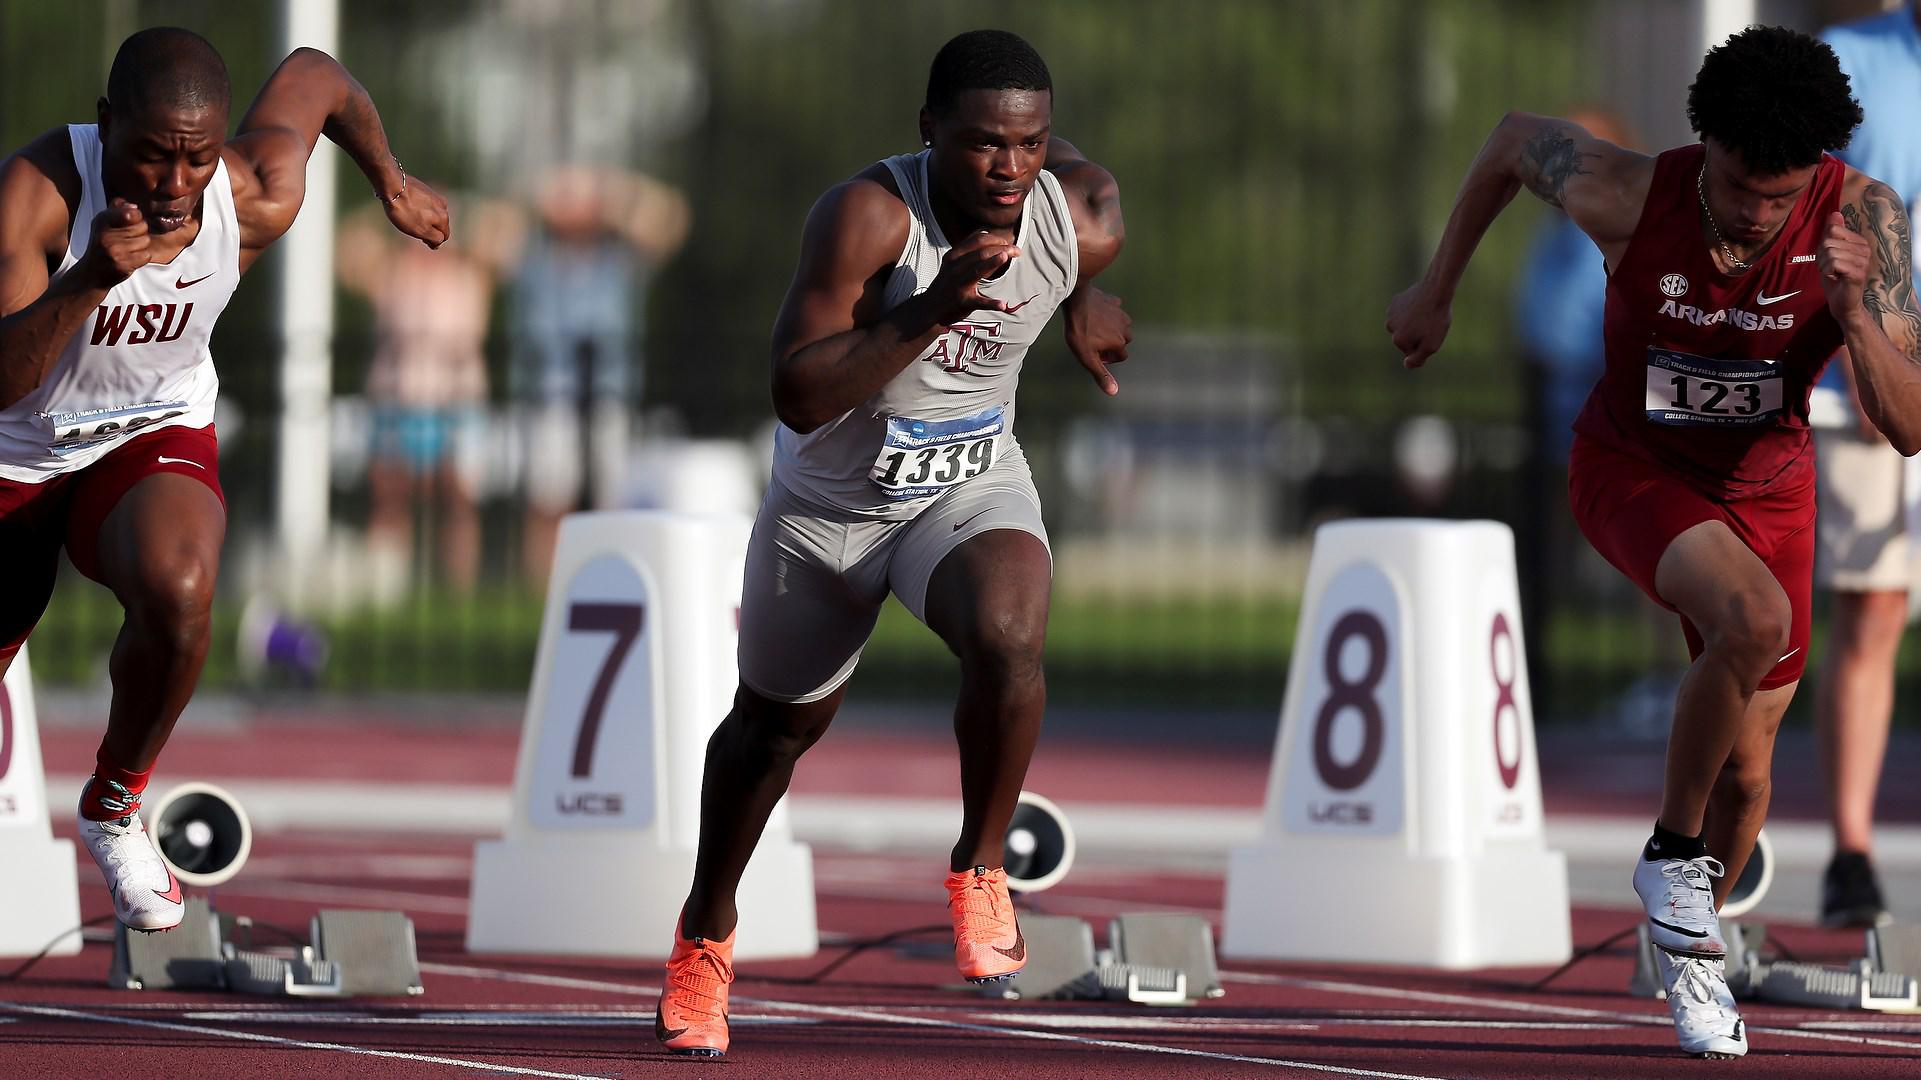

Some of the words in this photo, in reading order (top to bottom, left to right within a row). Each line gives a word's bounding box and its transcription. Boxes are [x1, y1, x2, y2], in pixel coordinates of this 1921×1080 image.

[1662, 275, 1686, 295] SEC
[90, 303, 194, 346] WSU
[1658, 300, 1794, 331] ARKANSAS
[1671, 361, 1692, 372] TRACK
[1698, 368, 1717, 376] FIELD
[1718, 369, 1776, 379] CHAMPIONSHIPS
[1670, 375, 1761, 415] 123
[911, 437, 930, 446] TRACK
[935, 434, 952, 443] FIELD
[952, 423, 1001, 440] CHAMPIONSHIPS
[876, 439, 993, 486] 1339
[568, 602, 644, 780] 7
[1312, 609, 1388, 793] 8
[1491, 612, 1523, 790] 8
[557, 794, 623, 815] UCS
[1308, 803, 1373, 824] UCS
